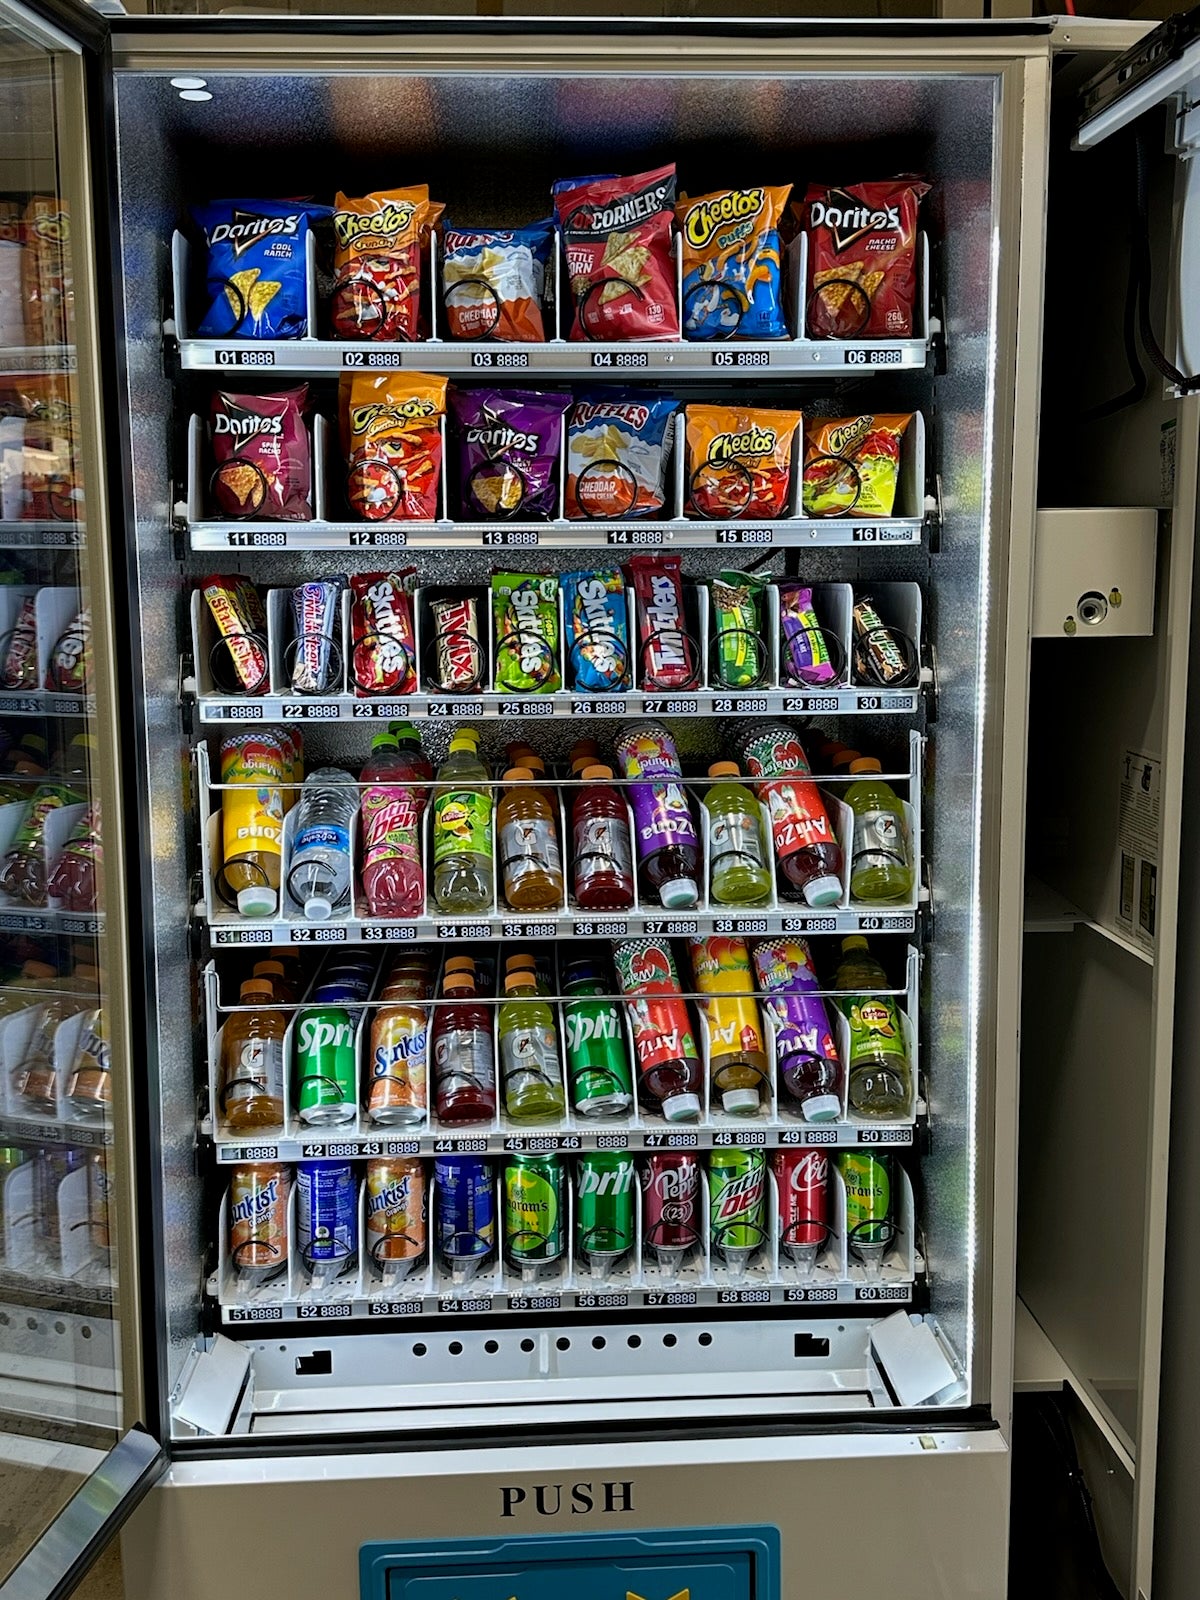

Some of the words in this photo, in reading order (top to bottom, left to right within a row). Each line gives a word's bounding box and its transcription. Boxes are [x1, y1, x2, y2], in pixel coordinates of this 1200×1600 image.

[687, 190, 760, 245] Cheetos
[811, 202, 900, 229] Doritos
[211, 215, 298, 244] Doritos
[333, 206, 412, 246] Cheetos
[717, 221, 754, 249] Puffs
[264, 249, 292, 258] RANCH
[648, 305, 662, 315] 130
[219, 352, 236, 364] 01
[241, 352, 273, 365] 8888
[346, 353, 364, 366] 02
[368, 353, 400, 366] 8888
[474, 353, 492, 366] 03
[496, 353, 528, 366] 8888
[594, 354, 612, 366] 04
[616, 354, 647, 366] 8888
[715, 352, 733, 365] 05
[738, 353, 768, 366] 8888
[848, 351, 866, 364] 06
[571, 402, 649, 430] RUFFLES
[215, 413, 282, 435] Doritos
[466, 428, 539, 452] Doritos
[708, 428, 774, 466] Cheetos
[578, 482, 616, 492] CHEDDAR
[231, 534, 250, 546] 11
[253, 534, 284, 546] 8888
[352, 534, 370, 544] 12
[374, 534, 406, 546] 8888
[485, 532, 504, 544] 13
[507, 532, 538, 544] 8888
[610, 532, 628, 544] 14
[632, 532, 662, 544] 8888
[719, 530, 738, 542] 15
[741, 530, 772, 542] 8888
[856, 529, 874, 541] 16
[368, 582, 402, 675] Skittles
[510, 590, 544, 674] Skittles
[578, 579, 617, 673] Skittles
[440, 600, 474, 681] TWIX
[502, 703, 520, 714] 25
[522, 704, 553, 714] 8888
[574, 702, 592, 713] 26
[595, 702, 626, 713] 8888
[645, 701, 662, 712] 27
[666, 702, 696, 712] 8888
[715, 700, 732, 712] 28
[736, 701, 766, 712] 8888
[786, 699, 804, 711] 29
[808, 700, 838, 710] 8888
[860, 698, 878, 709] 30
[230, 707, 262, 718] 8888
[285, 706, 302, 718] 22
[308, 706, 338, 718] 8888
[355, 705, 373, 716] 23
[378, 706, 408, 716] 8888
[430, 704, 447, 716] 24
[452, 705, 482, 716] 8888
[237, 825, 283, 845] Zona
[646, 922, 662, 934] 37
[667, 923, 697, 934] 8888
[716, 921, 733, 932] 38
[737, 921, 766, 932] 8888
[784, 920, 802, 930] 39
[806, 920, 836, 930] 8888
[862, 918, 878, 928] 40
[292, 930, 310, 941] 32
[315, 930, 345, 940] 8888
[366, 928, 382, 940] 33
[385, 928, 415, 939] 8888
[440, 926, 457, 938] 34
[461, 926, 490, 937] 8888
[504, 925, 522, 936] 35
[526, 926, 555, 936] 8888
[576, 924, 593, 935] 36
[597, 924, 626, 936] 8888
[218, 932, 234, 942] 31
[240, 931, 272, 942] 8888
[566, 1008, 622, 1052] Spri
[298, 1017, 354, 1058] Spri
[638, 1028, 679, 1062] AriZ
[562, 1137, 578, 1148] 46
[598, 1136, 627, 1148] 8888
[646, 1135, 662, 1146] 47
[668, 1136, 697, 1146] 8888
[714, 1134, 732, 1144] 48
[736, 1134, 765, 1144] 8888
[782, 1132, 799, 1143] 49
[808, 1132, 836, 1143] 8888
[862, 1130, 878, 1142] 50
[362, 1144, 380, 1154] 43
[388, 1142, 418, 1154] 8888
[436, 1140, 452, 1151] 44
[456, 1140, 487, 1151] 8888
[506, 1138, 523, 1150] 45
[529, 1138, 558, 1150] 8888
[246, 1147, 276, 1158] 8888
[304, 1145, 322, 1156] 42
[329, 1145, 358, 1156] 8888
[678, 1163, 696, 1184] Dr
[230, 1179, 279, 1224] unkist
[367, 1176, 411, 1217] unkist
[511, 1200, 548, 1214] gram's
[670, 1206, 684, 1220] 23
[648, 1294, 664, 1304] 57
[668, 1294, 696, 1304] 8888
[721, 1291, 738, 1302] 58
[740, 1292, 770, 1302] 8888
[788, 1290, 804, 1300] 59
[808, 1290, 836, 1300] 8888
[860, 1288, 876, 1299] 60
[442, 1300, 458, 1312] 54
[461, 1301, 490, 1312] 8888
[510, 1298, 528, 1309] 55
[530, 1298, 560, 1308] 8888
[578, 1296, 595, 1306] 56
[598, 1296, 626, 1306] 8888
[233, 1309, 249, 1320] 51
[250, 1309, 280, 1319] 8888
[300, 1306, 318, 1318] 52
[320, 1306, 350, 1318] 8888
[372, 1304, 389, 1314] 53
[392, 1304, 421, 1314] 8888
[500, 1481, 636, 1517] PUSH
